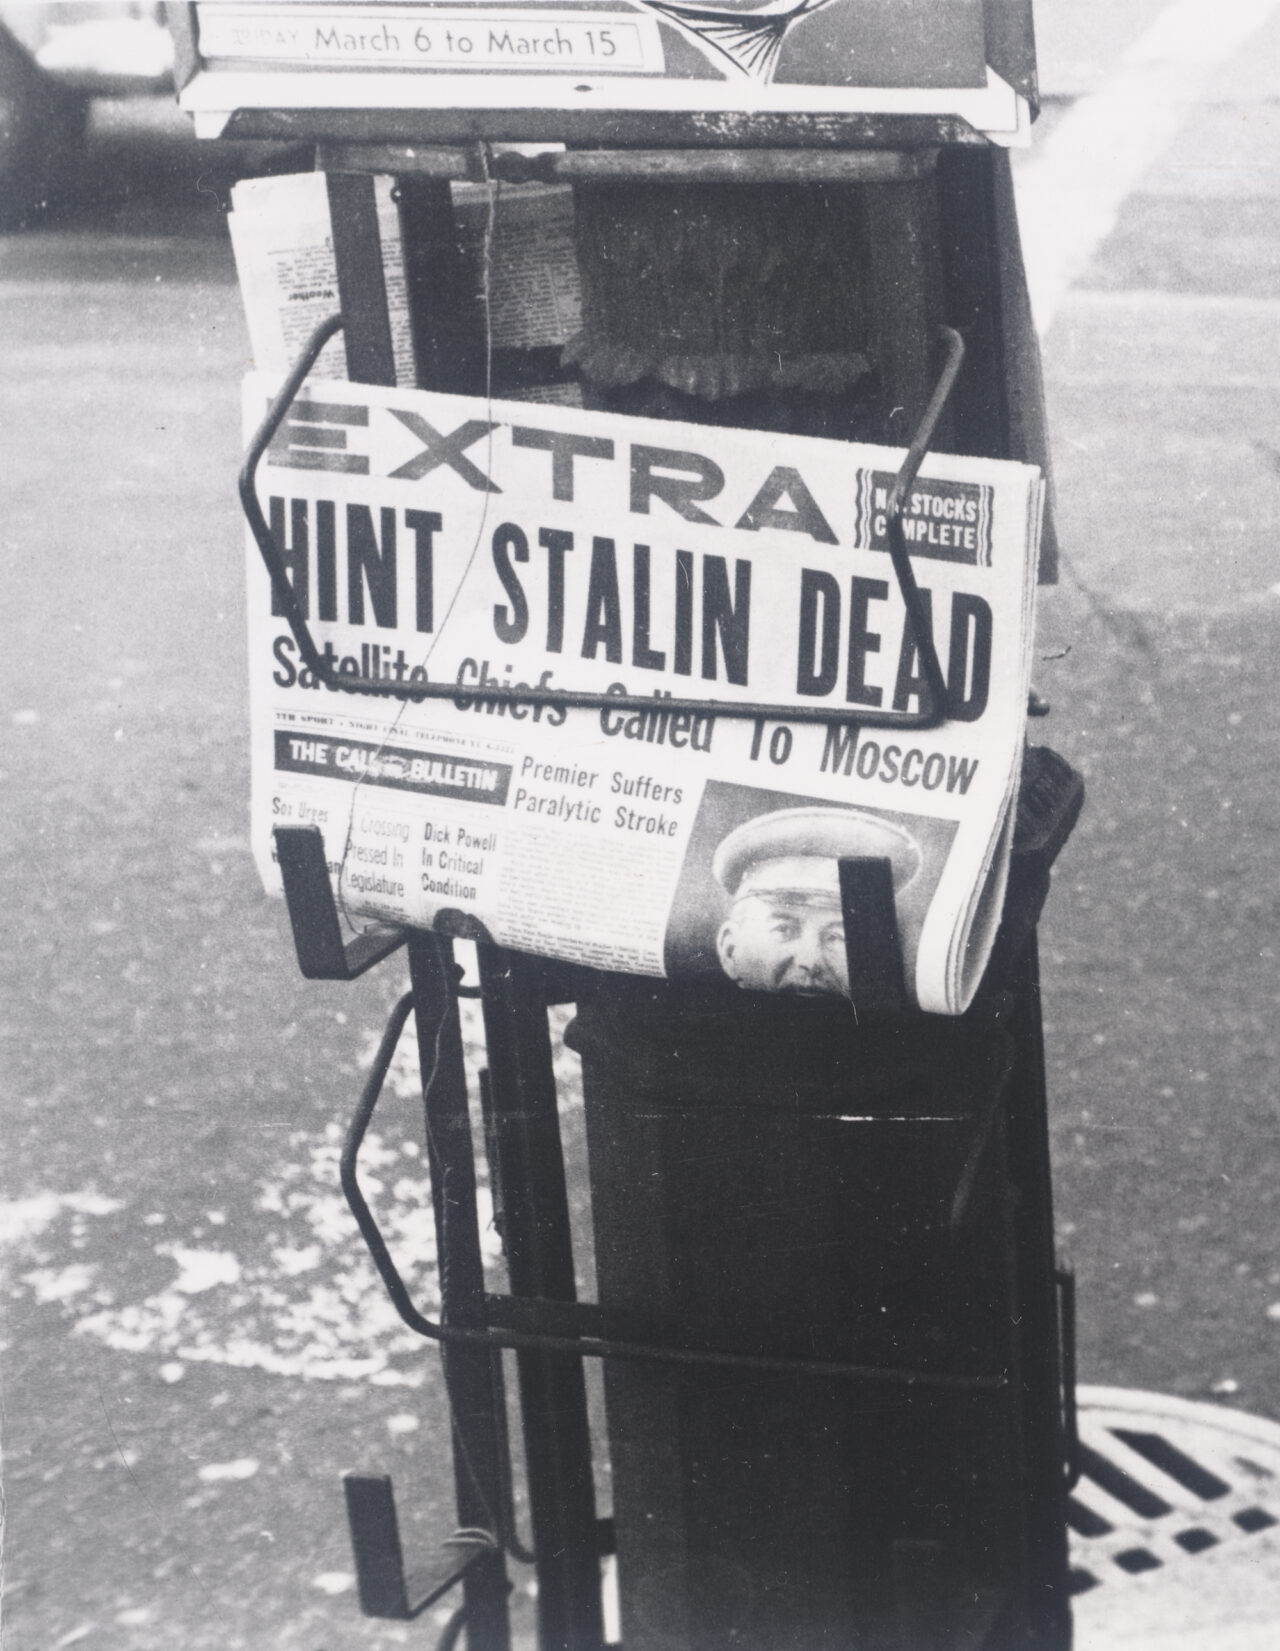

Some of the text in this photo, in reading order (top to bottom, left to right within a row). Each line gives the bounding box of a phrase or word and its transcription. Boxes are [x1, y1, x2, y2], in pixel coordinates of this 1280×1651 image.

[315, 25, 400, 52] March
[414, 27, 432, 53] 6
[446, 28, 473, 54] to
[488, 28, 573, 56] March
[586, 31, 616, 57] 15
[267, 397, 840, 546] EXTRA
[911, 492, 977, 523] STOCKS
[874, 514, 976, 550] CMPLETE
[269, 495, 993, 722] HINT STALIN DEAD
[273, 635, 980, 796] Satellite Chiefs Called To Moscow
[289, 739, 328, 765] THE
[410, 758, 499, 792] BULLETIN
[521, 756, 684, 805] Premier Suffers
[360, 811, 410, 843] Crossing
[514, 788, 679, 838] Paralytic Stroke
[347, 838, 388, 866] Pressed
[424, 822, 498, 851] Dick Powell
[422, 847, 484, 876] In Critical
[345, 866, 405, 898] Legislature
[421, 873, 477, 900] Condition
